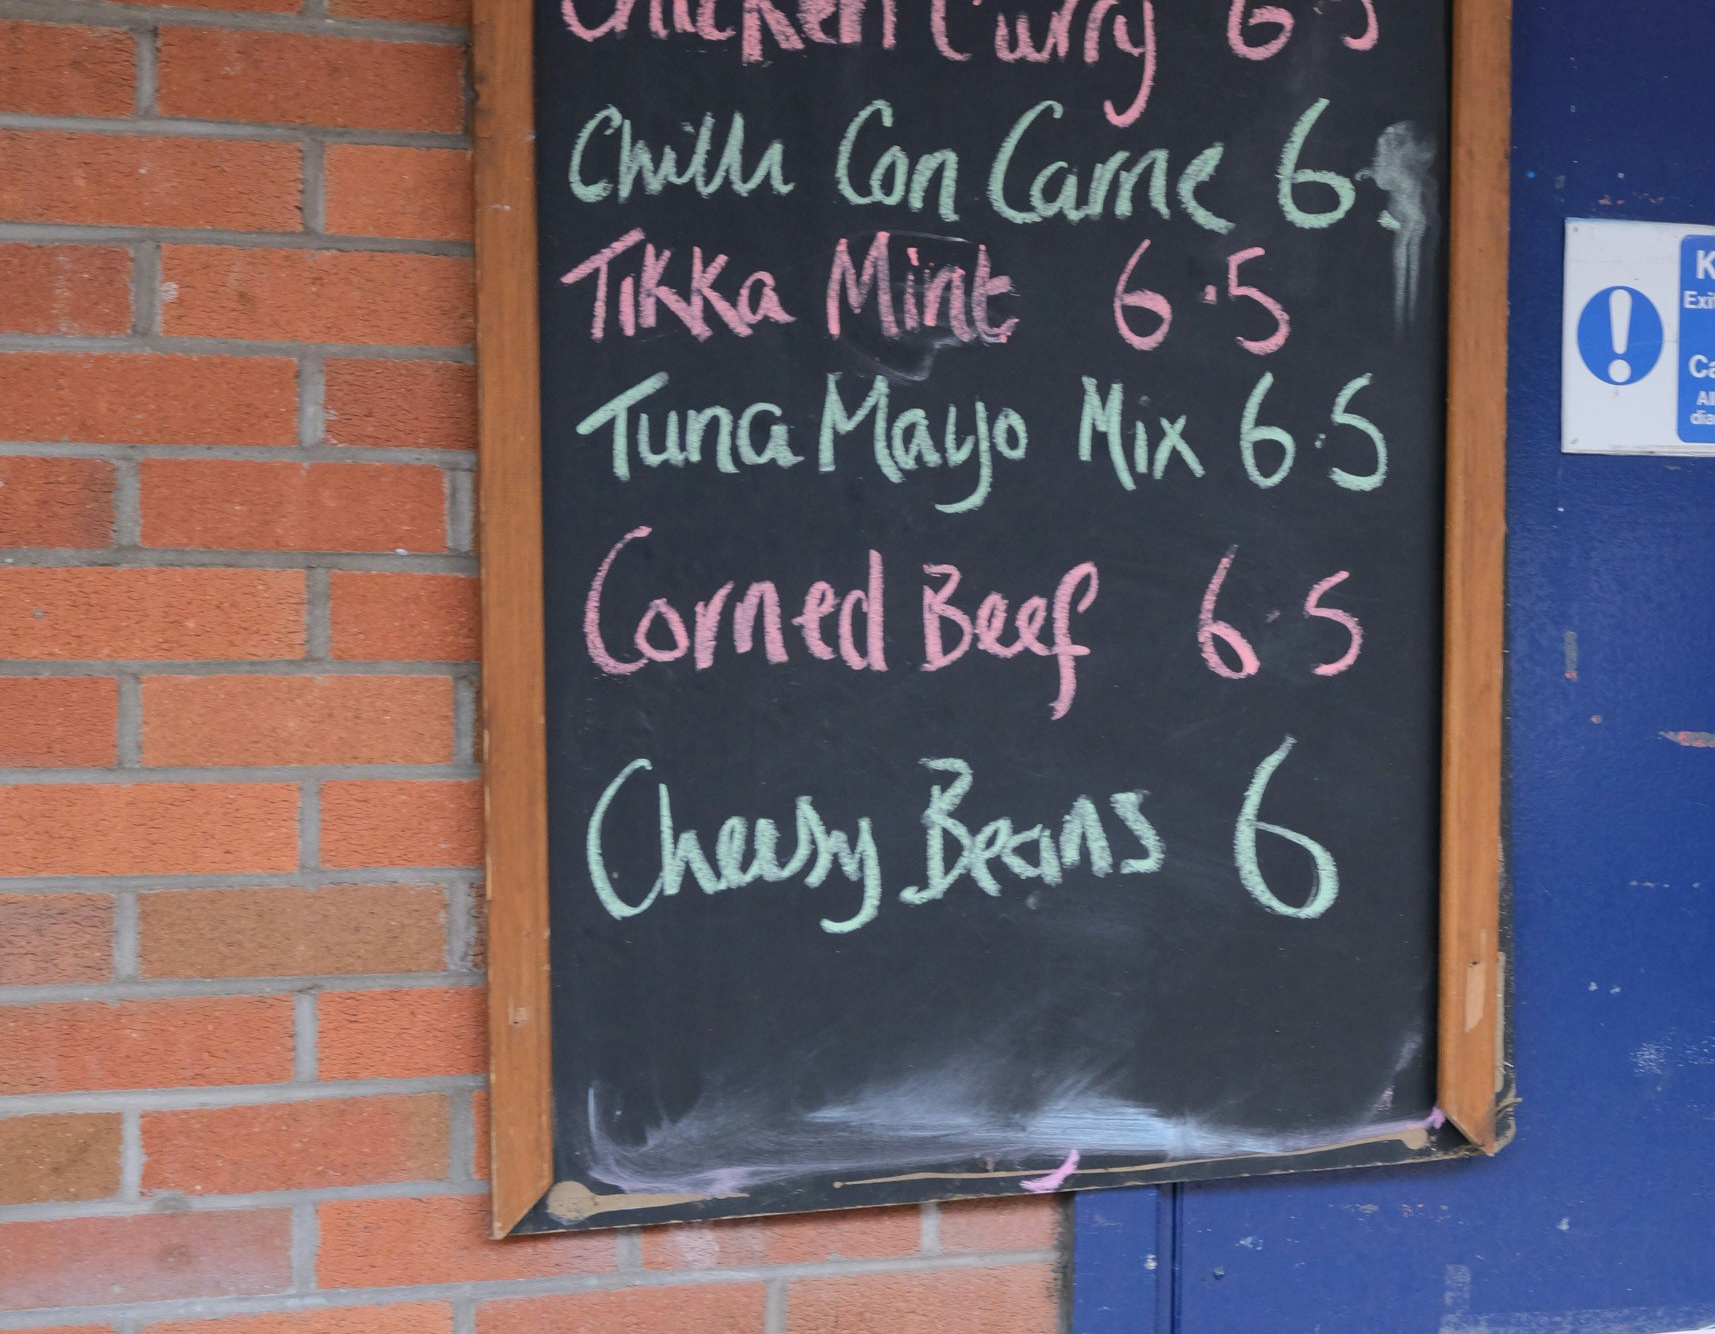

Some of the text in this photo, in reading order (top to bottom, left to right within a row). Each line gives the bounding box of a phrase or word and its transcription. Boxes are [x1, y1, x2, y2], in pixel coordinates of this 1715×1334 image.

[569, 104, 795, 203] Chilli
[834, 98, 960, 222] Con
[987, 99, 1237, 231] Carne
[824, 230, 1020, 342] Mint
[1112, 238, 1290, 356] 6.5
[575, 370, 1388, 513] Tuna Mayo Mix 6.5
[583, 523, 888, 676] Corned
[921, 561, 1099, 720] Beef
[588, 734, 1338, 935] Cheesy Beans 6
